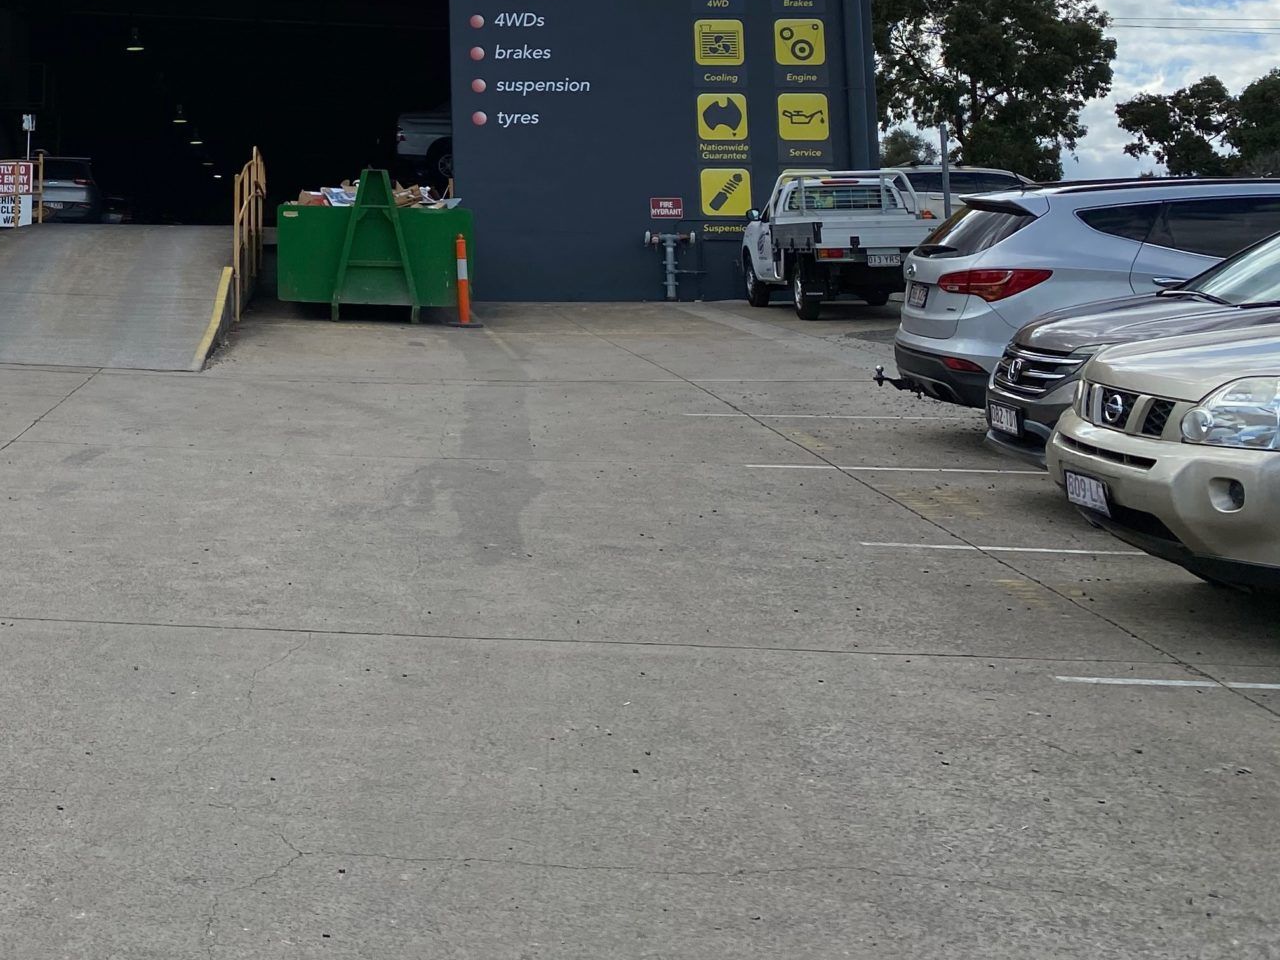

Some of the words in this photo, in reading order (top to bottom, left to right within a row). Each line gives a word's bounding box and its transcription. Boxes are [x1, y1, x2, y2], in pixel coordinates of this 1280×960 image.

[707, 0, 729, 8] 4WD
[494, 13, 545, 27] 4WDs
[495, 44, 551, 59] brakes
[704, 73, 738, 83] Cooling
[786, 73, 818, 83] Engine
[496, 78, 590, 96] suspension
[497, 111, 539, 127] tyres
[699, 143, 749, 151] Nationwide
[789, 147, 822, 156] Service
[702, 151, 747, 160] Guarantee
[4, 175, 27, 183] ENRY
[703, 224, 746, 234] Suspensio
